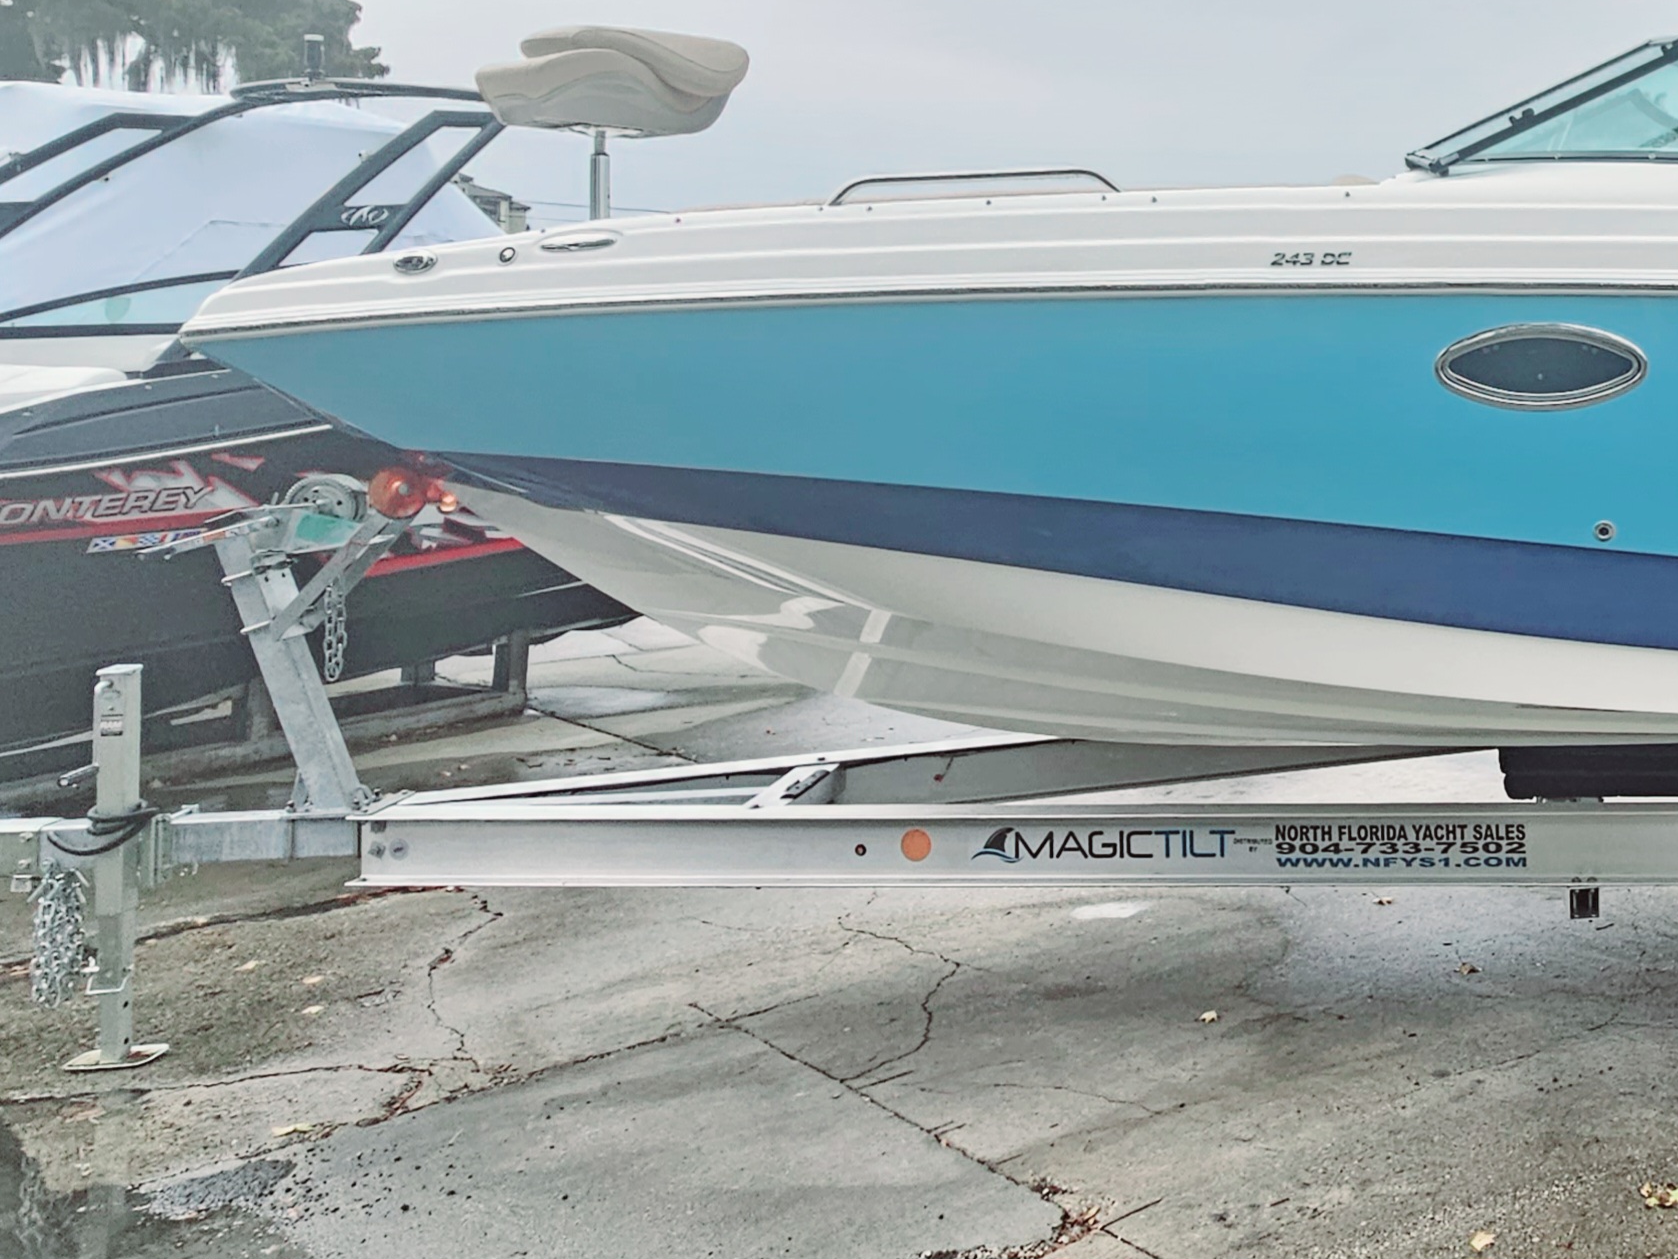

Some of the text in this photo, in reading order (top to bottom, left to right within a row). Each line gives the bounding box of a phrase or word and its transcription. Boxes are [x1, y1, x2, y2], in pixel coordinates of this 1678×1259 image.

[1270, 252, 1315, 266] 243
[0, 486, 214, 525] ONTEREY
[1275, 824, 1526, 842] NORTH FLORIDA YACHT SALES
[1014, 830, 1236, 859] MAGICTILT
[1275, 842, 1527, 855] 904-733-7502
[1276, 857, 1527, 868] WWW.NFYS1.COM
